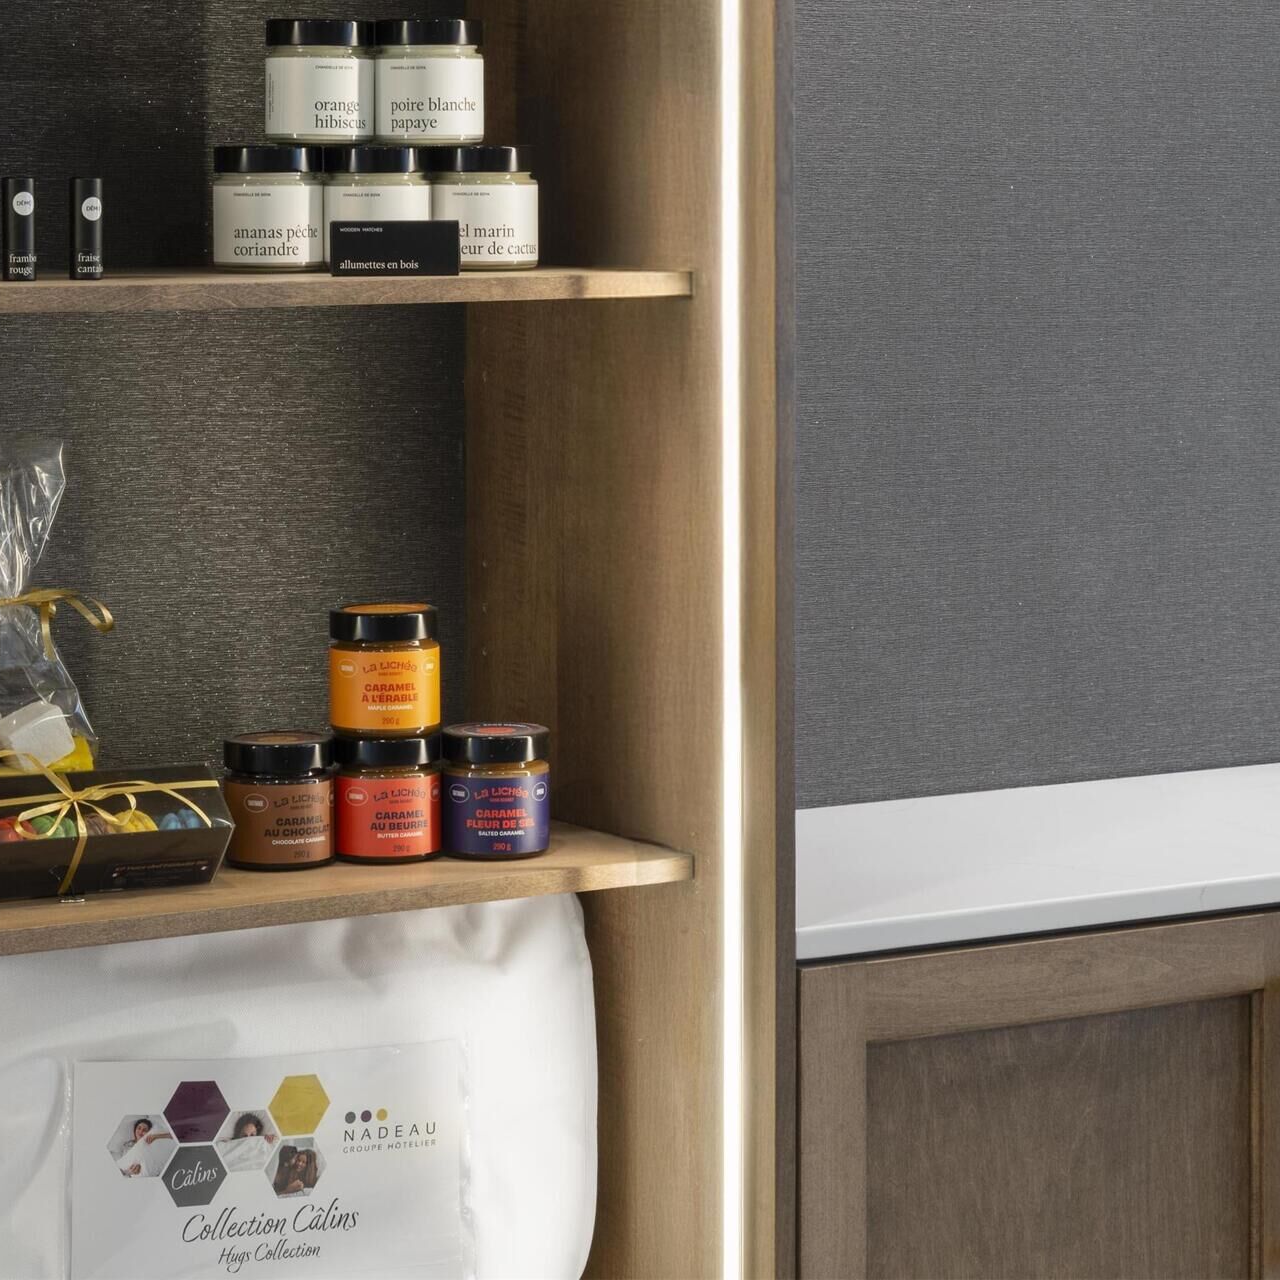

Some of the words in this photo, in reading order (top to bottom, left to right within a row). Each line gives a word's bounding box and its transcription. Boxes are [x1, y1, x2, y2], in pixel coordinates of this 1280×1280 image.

[314, 99, 360, 115] orange
[391, 98, 425, 115] poire
[428, 97, 476, 112] blanche
[314, 114, 366, 129] hibiscus
[391, 117, 438, 132] papaye
[233, 226, 283, 239] ananas
[286, 224, 318, 241] pêche
[473, 223, 515, 238] marin
[233, 241, 299, 257] coriandre
[487, 240, 504, 255] de
[507, 240, 537, 256] cactus
[9, 267, 33, 276] rouge
[339, 259, 386, 270] allumettes
[387, 262, 398, 270] en
[400, 259, 419, 270] bois
[364, 683, 416, 692] CARAMEL
[372, 692, 419, 703] L'ÉRABLE
[276, 815, 322, 826] CARAMEL
[375, 810, 424, 820] CARAMEL
[475, 808, 527, 818] CARAMEL
[264, 828, 280, 837] AU
[282, 823, 330, 837] CHOCOLAT
[370, 822, 386, 831] AU
[388, 819, 428, 830] BEURRE
[466, 818, 500, 829] FLEUR
[502, 819, 516, 829] DE
[518, 817, 535, 829] SEL
[343, 1120, 437, 1142] NADEAU
[342, 1143, 384, 1154] GROUPE
[386, 1138, 437, 1150] HÔTELIER
[171, 1160, 218, 1192] Câlins
[182, 1206, 288, 1243] Collection
[292, 1197, 359, 1233] Câlins
[218, 1246, 252, 1273] Hugs
[254, 1238, 321, 1262] Collection
